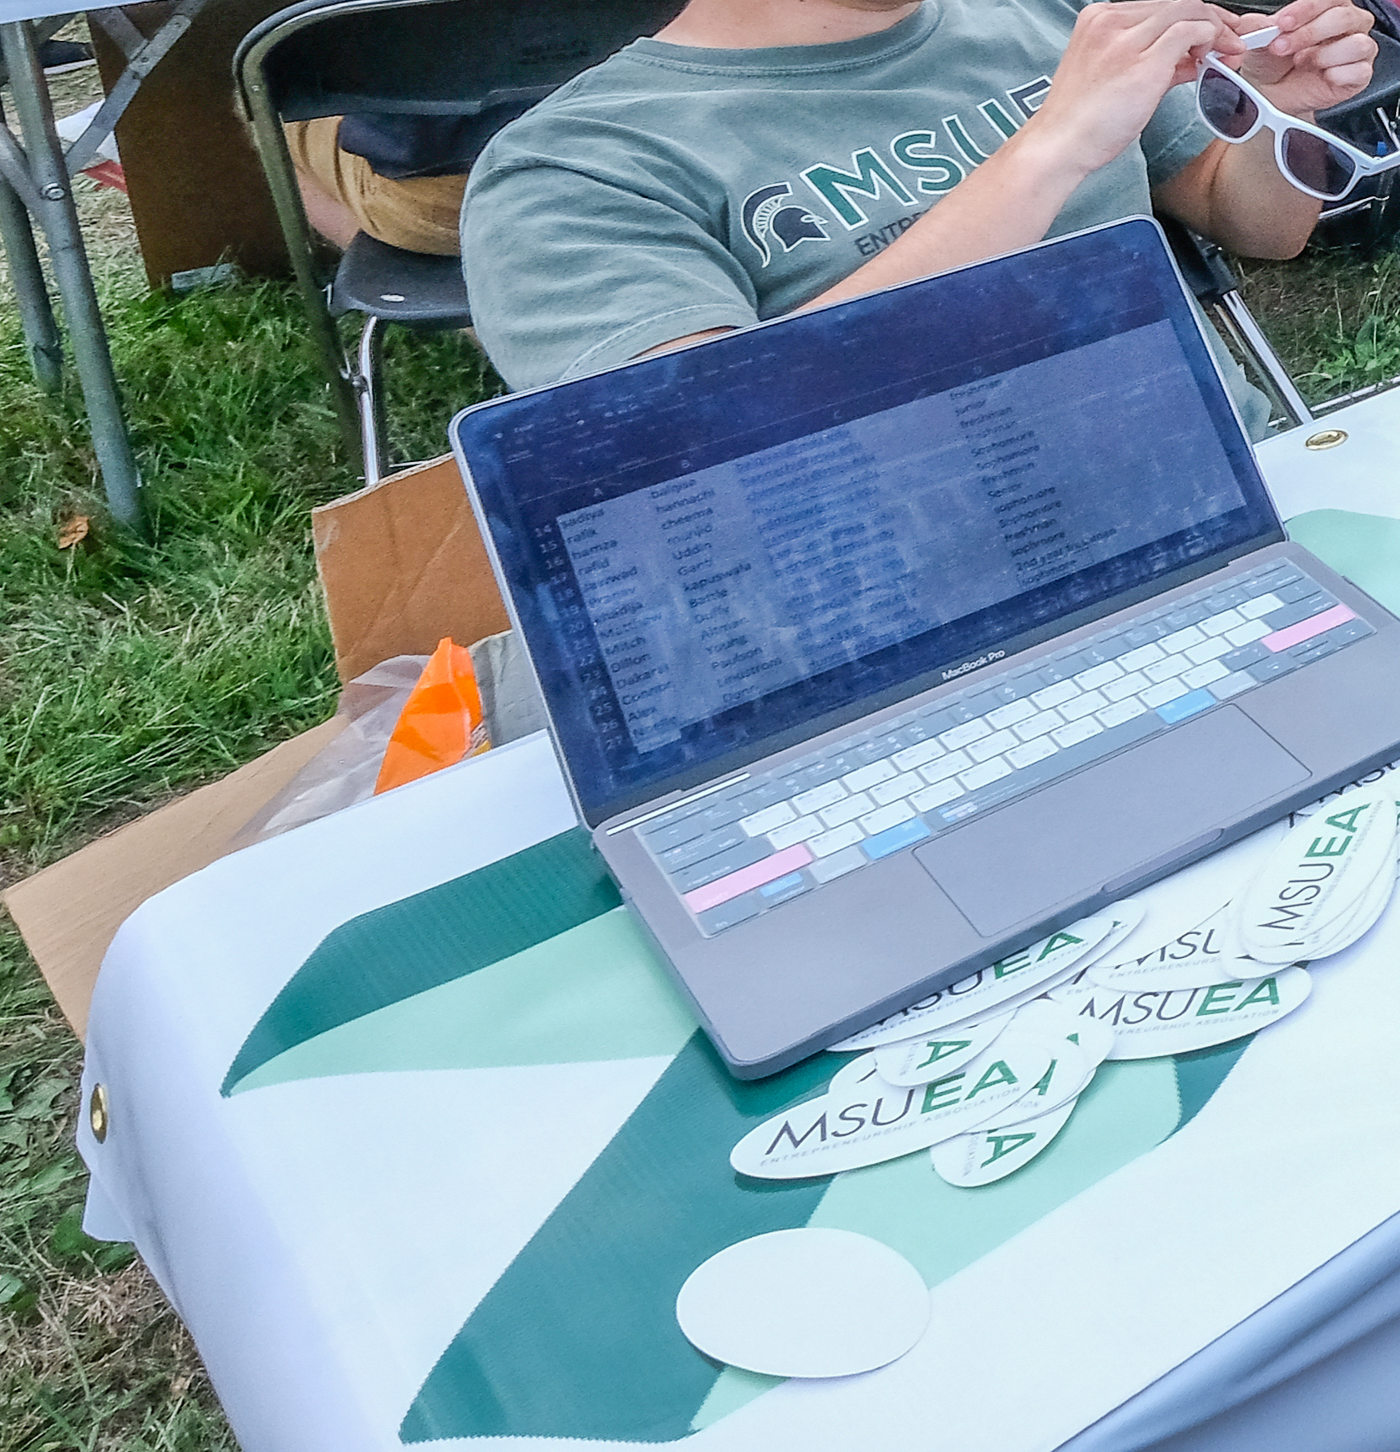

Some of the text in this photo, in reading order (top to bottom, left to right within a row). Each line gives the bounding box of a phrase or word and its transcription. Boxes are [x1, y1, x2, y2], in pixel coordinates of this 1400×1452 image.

[941, 649, 1006, 680] MacBook Pro
[1257, 802, 1373, 931] MSUEA
[1078, 976, 1281, 1026] MSUEA
[764, 1059, 1018, 1156] MSUEA
